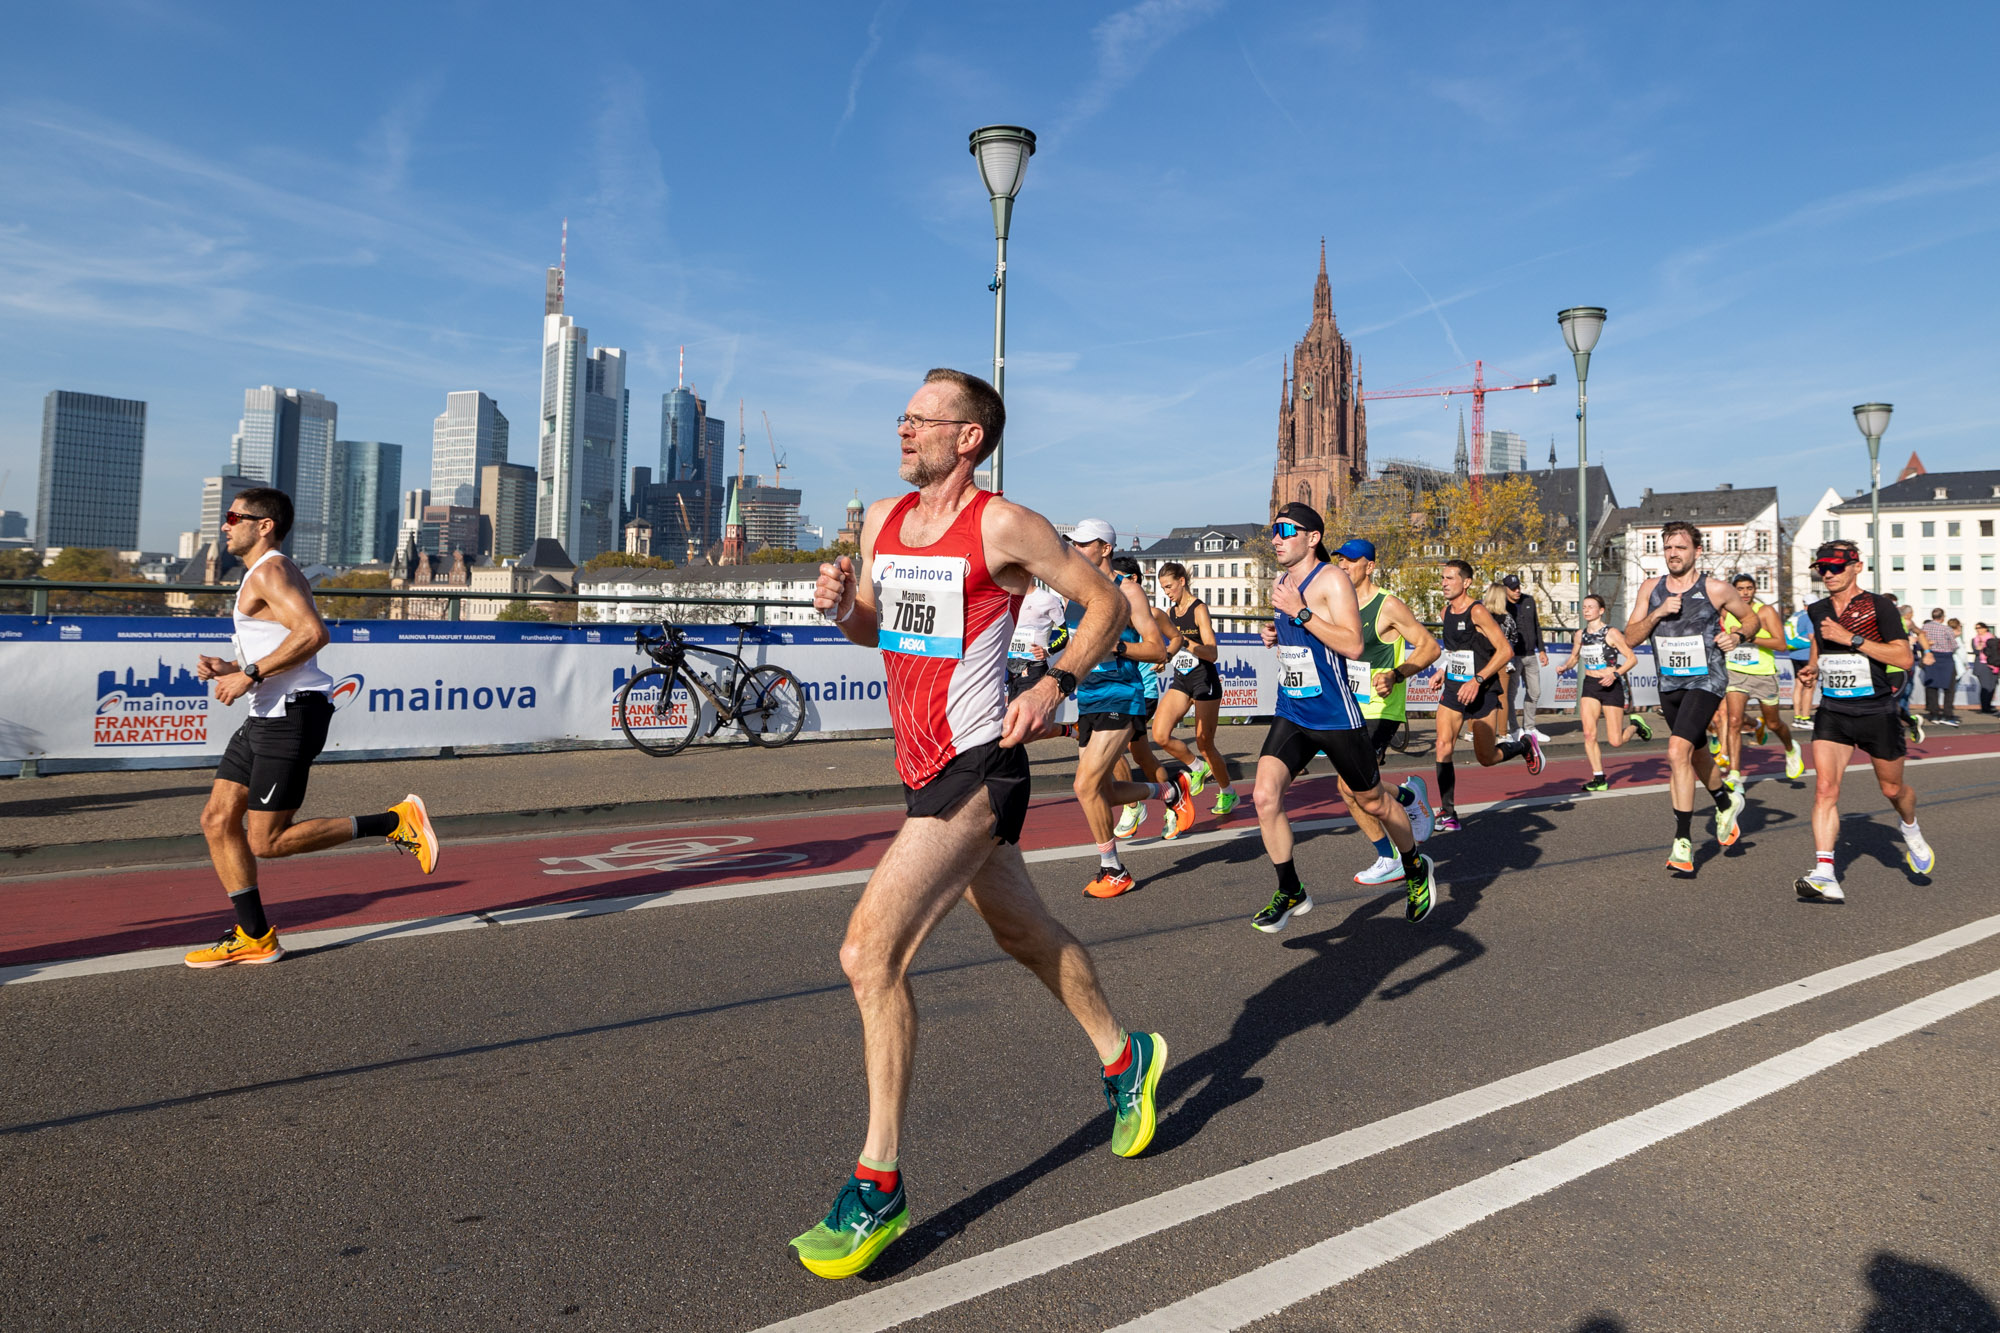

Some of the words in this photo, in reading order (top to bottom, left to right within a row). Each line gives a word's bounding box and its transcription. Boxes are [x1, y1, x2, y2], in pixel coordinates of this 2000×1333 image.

[894, 565, 953, 582] mainova
[902, 590, 926, 603] Magnus
[892, 602, 936, 635] 7058
[520, 634, 564, 642] #runtheskyline
[898, 636, 927, 652] HOKA
[1347, 663, 1367, 673] inova
[1669, 655, 1691, 668] 5311
[1224, 677, 1258, 687] mainova
[1629, 671, 1658, 688] inova
[1828, 675, 1857, 689] 6322
[796, 674, 888, 702] maino
[1223, 689, 1258, 698] ANKFURT
[368, 679, 537, 712] mainova
[1220, 697, 1259, 706] ARATHON
[1406, 694, 1440, 702] MARATHON
[123, 696, 209, 712] mainova
[95, 714, 208, 730] FRANKFURT
[94, 728, 207, 743] MARATHON
